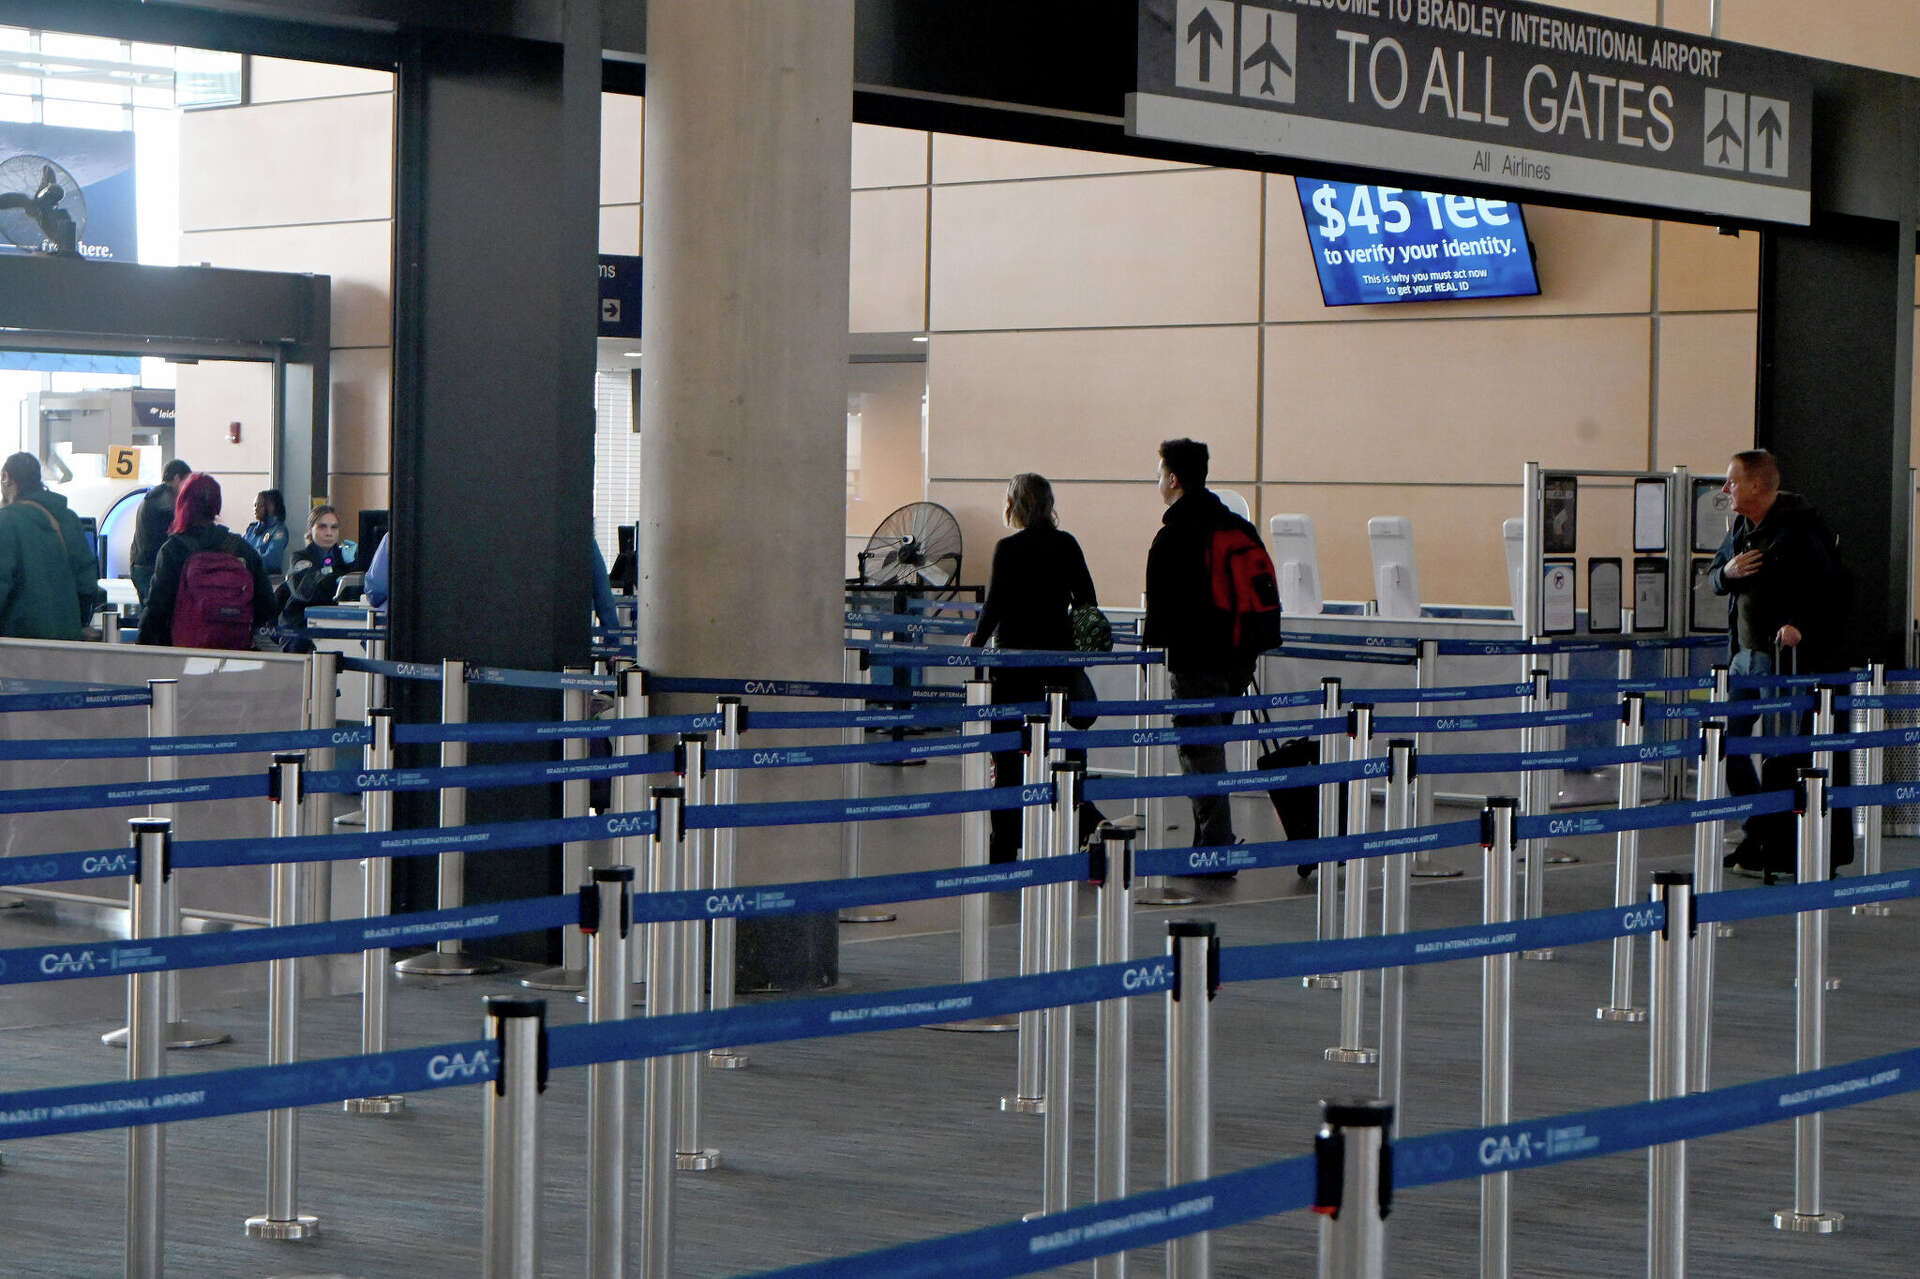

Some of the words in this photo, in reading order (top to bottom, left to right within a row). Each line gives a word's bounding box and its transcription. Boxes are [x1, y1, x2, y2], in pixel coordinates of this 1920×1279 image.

[1418, 0, 1507, 39] BRADLEY
[1512, 12, 1647, 65] INTERNATIONAL
[1651, 40, 1721, 78] AIRPORT
[1336, 30, 1408, 110] TO
[1418, 47, 1509, 127] ALL
[1523, 64, 1674, 151] GATES
[1473, 151, 1490, 173] All
[1502, 156, 1550, 181] Airlines
[1312, 183, 1412, 241] $45
[1421, 191, 1510, 230] fee
[78, 241, 112, 258] here.
[1324, 248, 1342, 265] to
[1345, 244, 1396, 264] verify
[1399, 244, 1440, 264] your
[1442, 238, 1517, 258] identity.
[1363, 275, 1382, 284] This
[1382, 274, 1390, 282] is
[1392, 273, 1410, 284] why
[1412, 274, 1428, 283] you
[1430, 271, 1452, 280] must
[1454, 270, 1466, 280] act
[1468, 269, 1488, 278] now
[1386, 286, 1396, 295] to
[1398, 286, 1412, 296] get
[1413, 284, 1433, 296] your
[1434, 282, 1458, 292] REAL
[1459, 282, 1470, 291] ID
[116, 450, 133, 476] 5
[0, 1108, 48, 1123] RADLEY
[50, 1099, 149, 1117] INTERNATIONAL
[152, 1091, 206, 1107] AIRPORT
